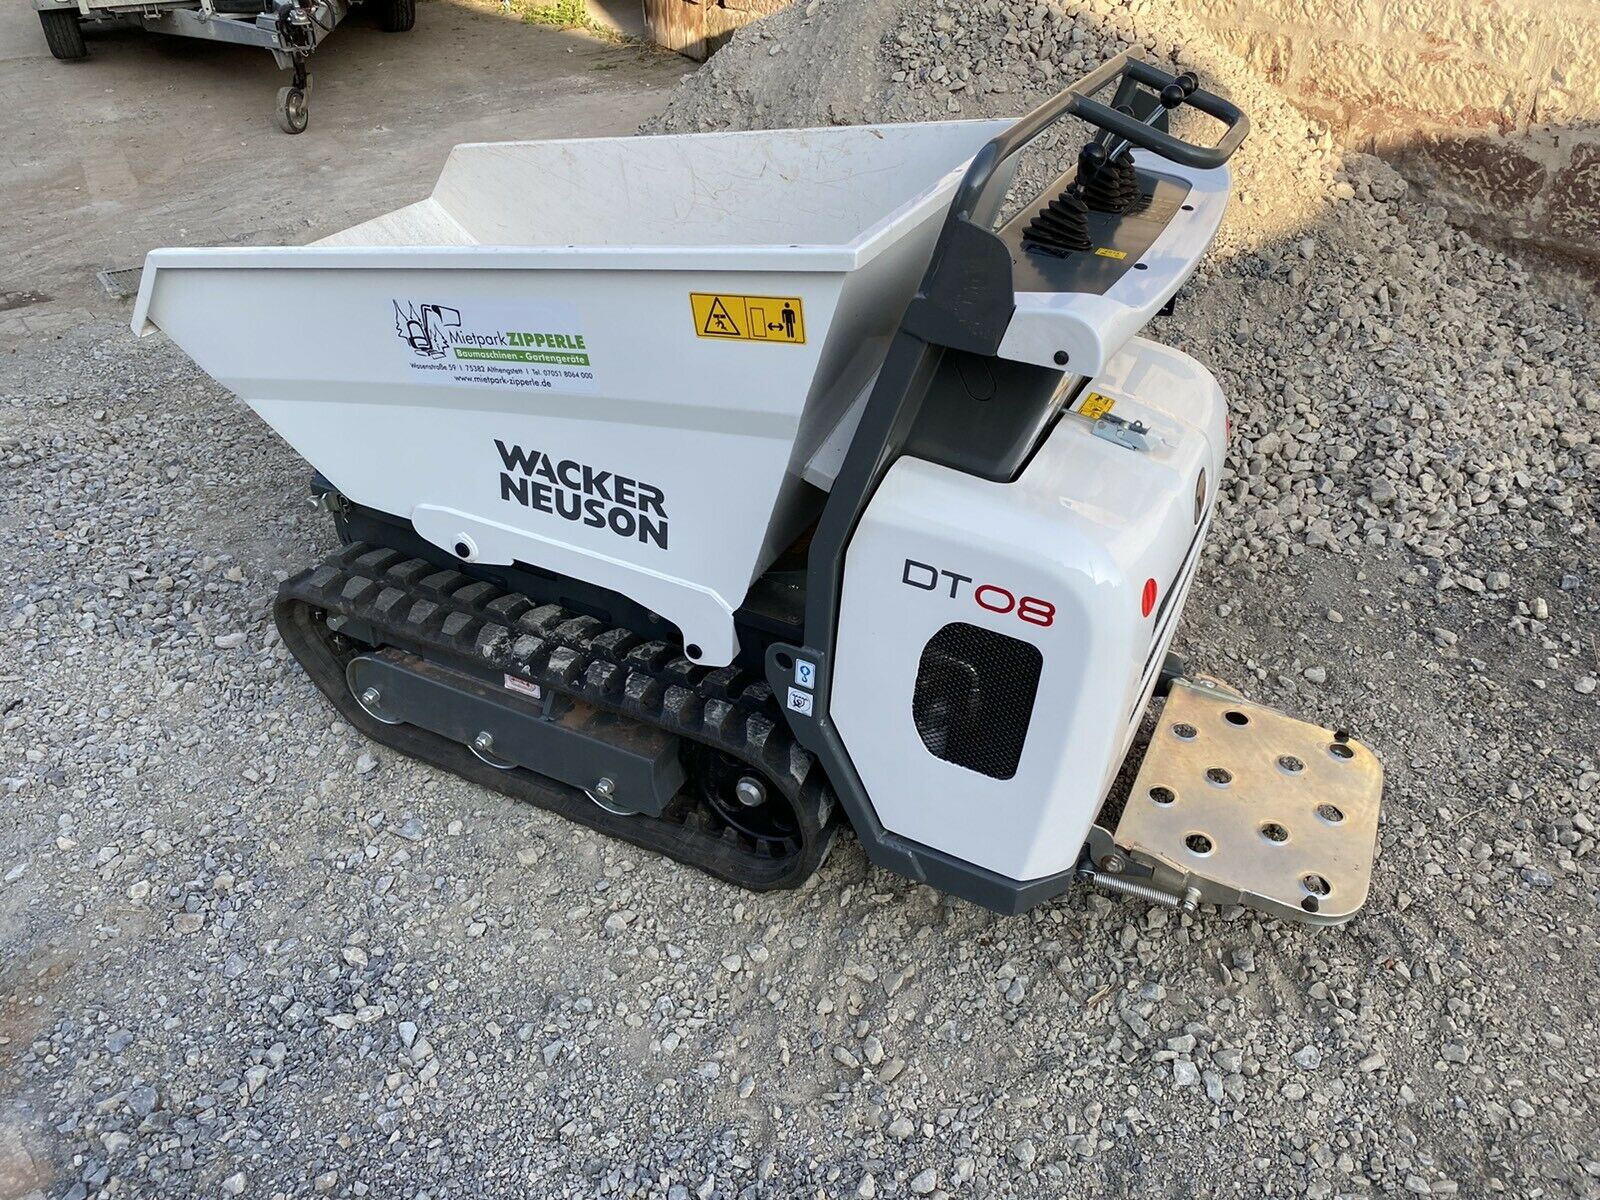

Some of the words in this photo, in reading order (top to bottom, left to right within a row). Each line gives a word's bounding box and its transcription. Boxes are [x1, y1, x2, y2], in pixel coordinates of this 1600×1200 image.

[456, 349, 518, 360] Baumaschinen
[465, 364, 485, 372] 75382
[543, 369, 562, 377] 07051
[454, 376, 551, 387] www.mietpark-zipperle.de
[494, 438, 669, 520] WACKER
[500, 471, 669, 551] NEUSON
[902, 558, 1056, 627] DT08
